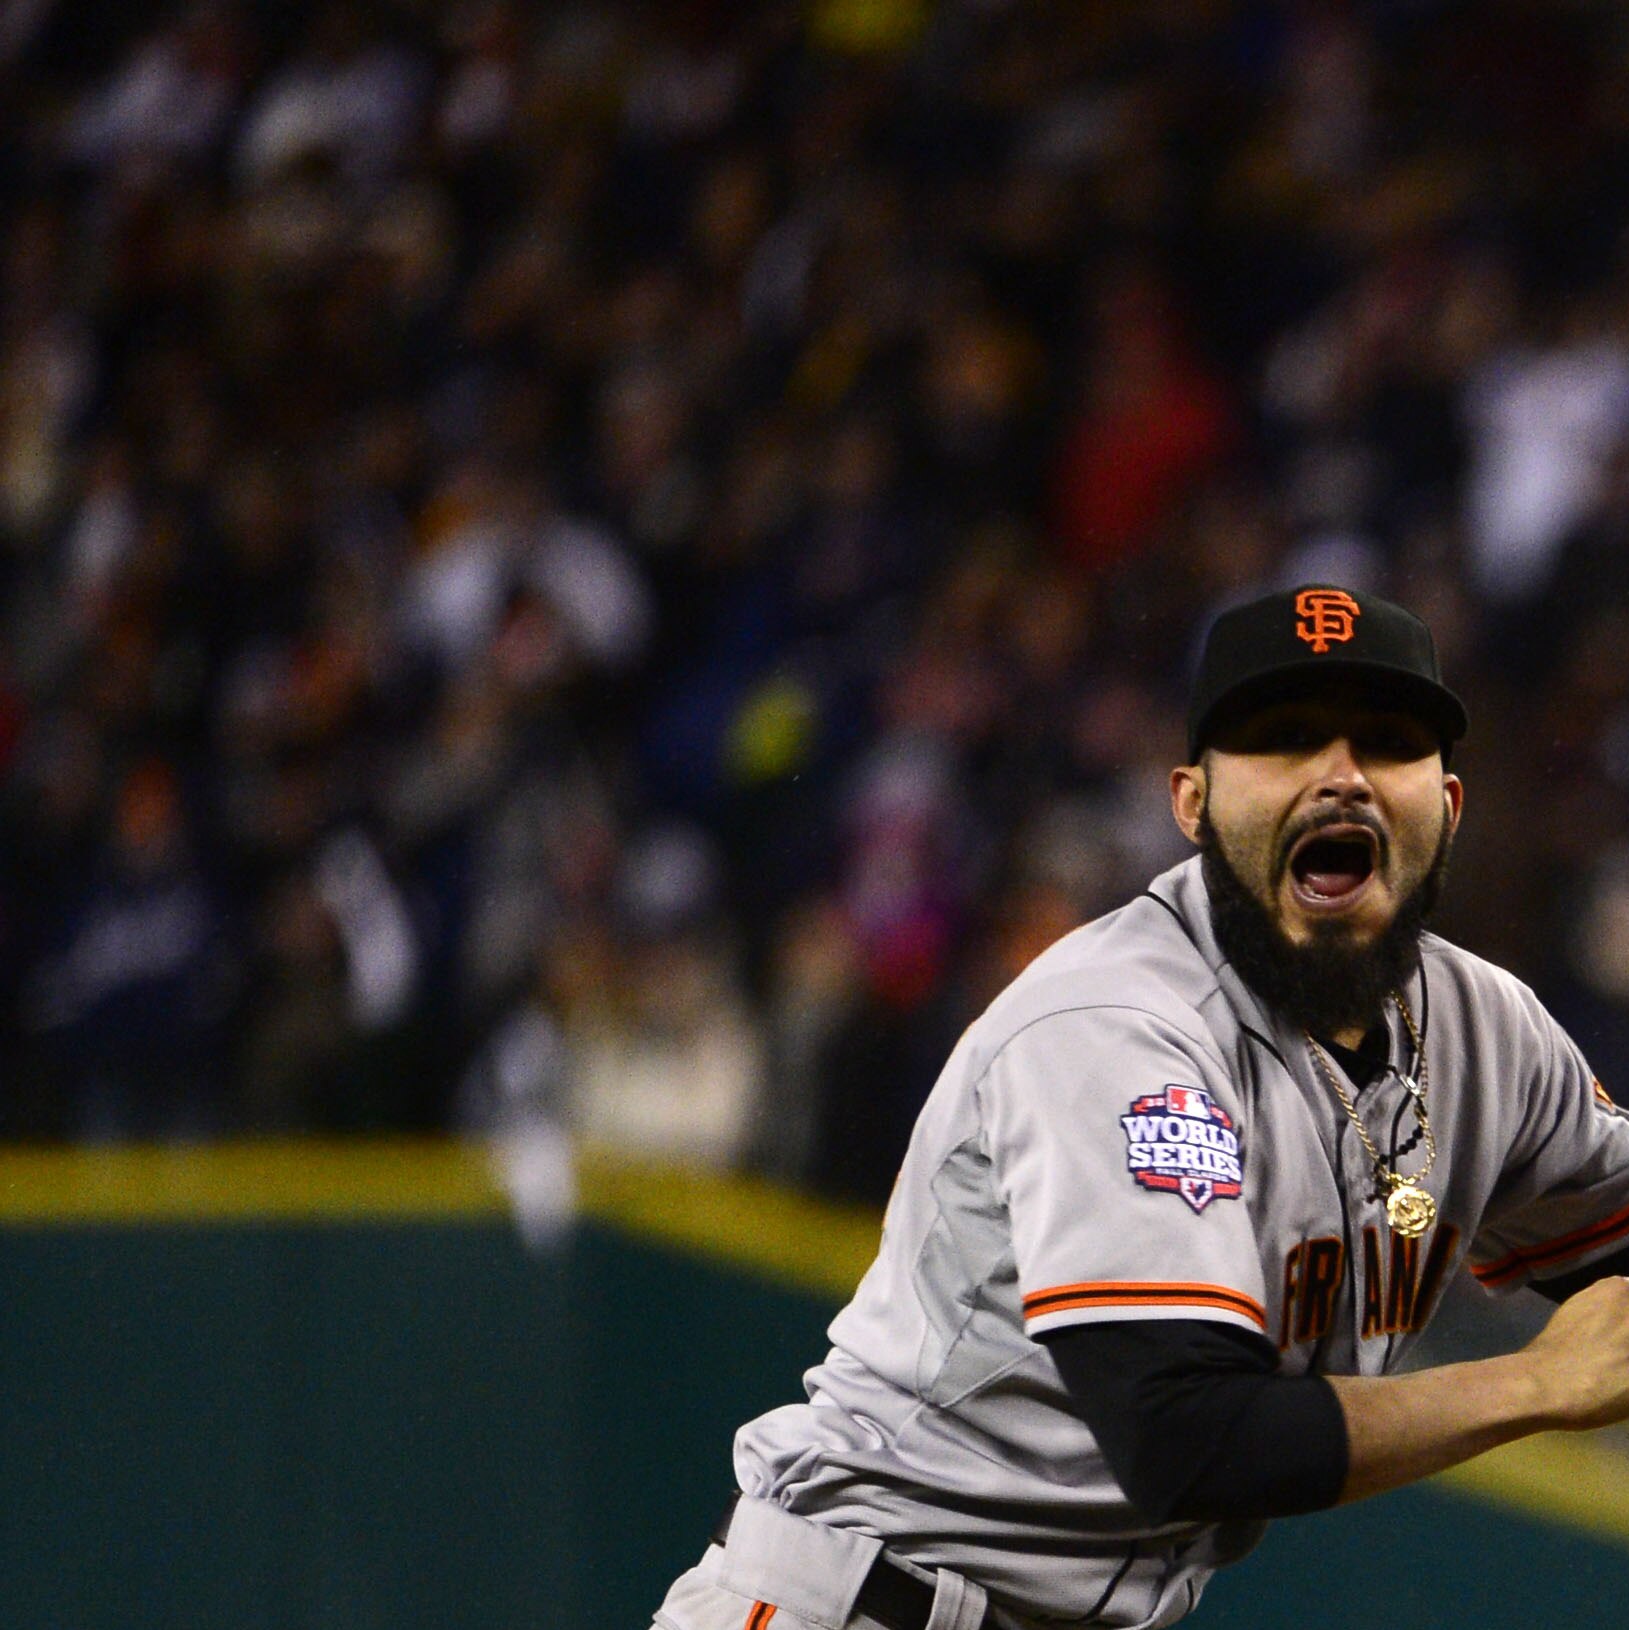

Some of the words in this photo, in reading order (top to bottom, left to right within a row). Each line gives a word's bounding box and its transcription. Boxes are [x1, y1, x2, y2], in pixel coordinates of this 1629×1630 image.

[1296, 589, 1361, 652] SF
[1120, 1115, 1239, 1156] WORLD
[1128, 1142, 1242, 1182] SERIES
